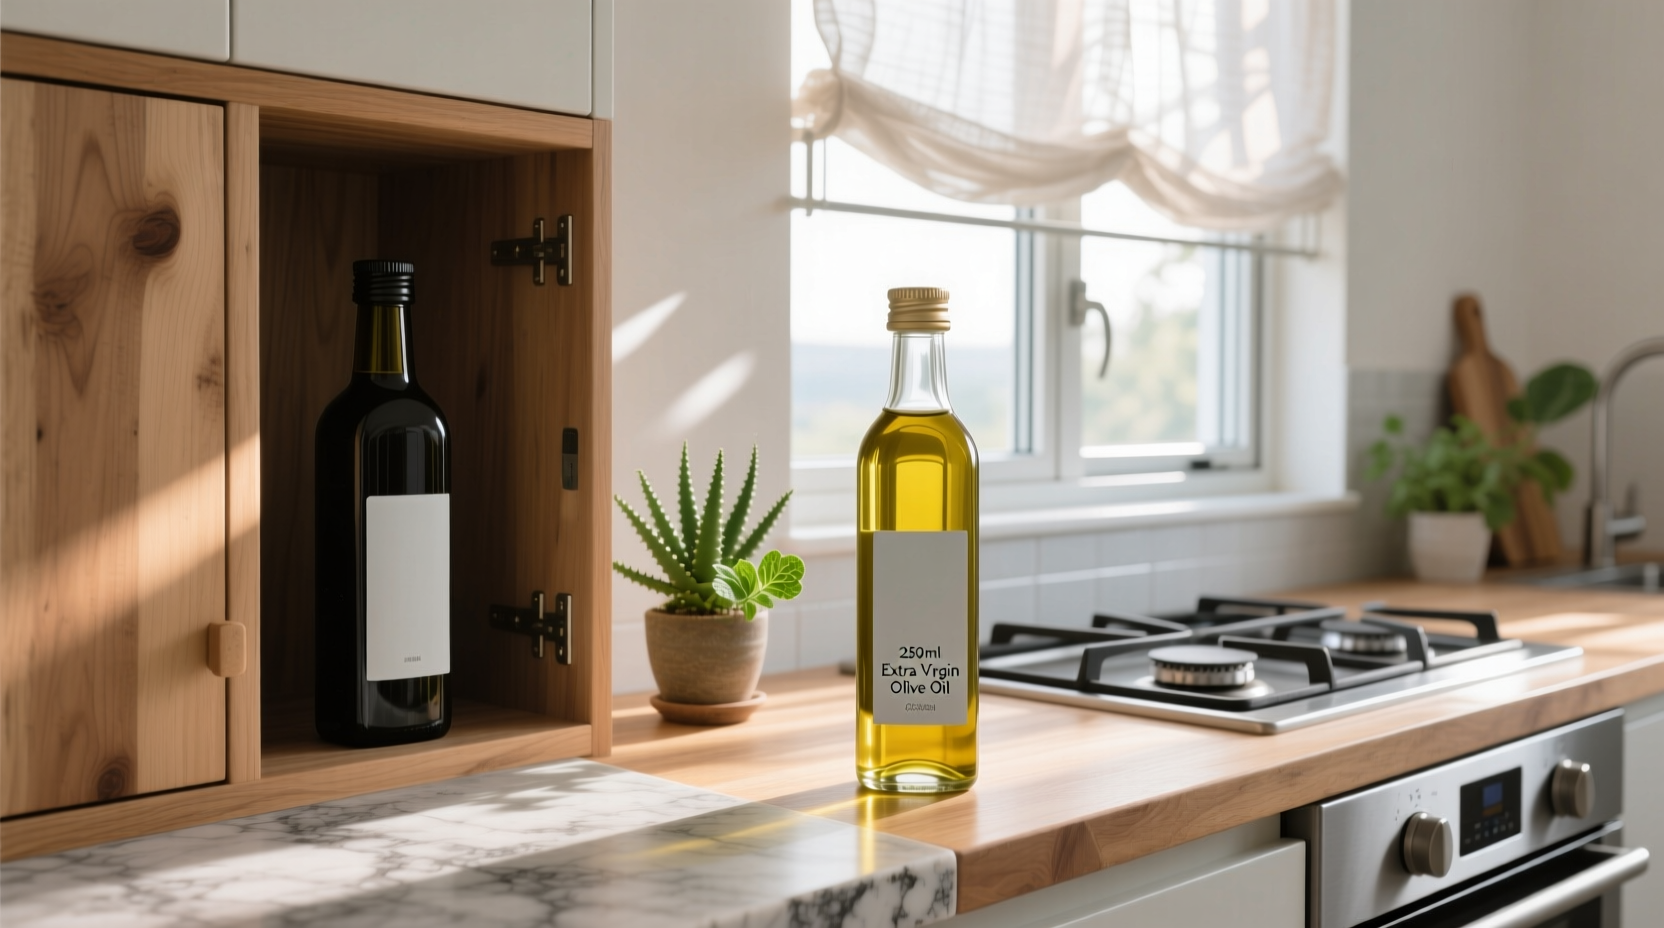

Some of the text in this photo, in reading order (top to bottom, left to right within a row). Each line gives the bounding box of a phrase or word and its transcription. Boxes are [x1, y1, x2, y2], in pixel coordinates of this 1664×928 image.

[898, 646, 941, 659] 250ml
[881, 663, 960, 680] Extra Vrgin
[890, 680, 950, 694] Olive Oil
